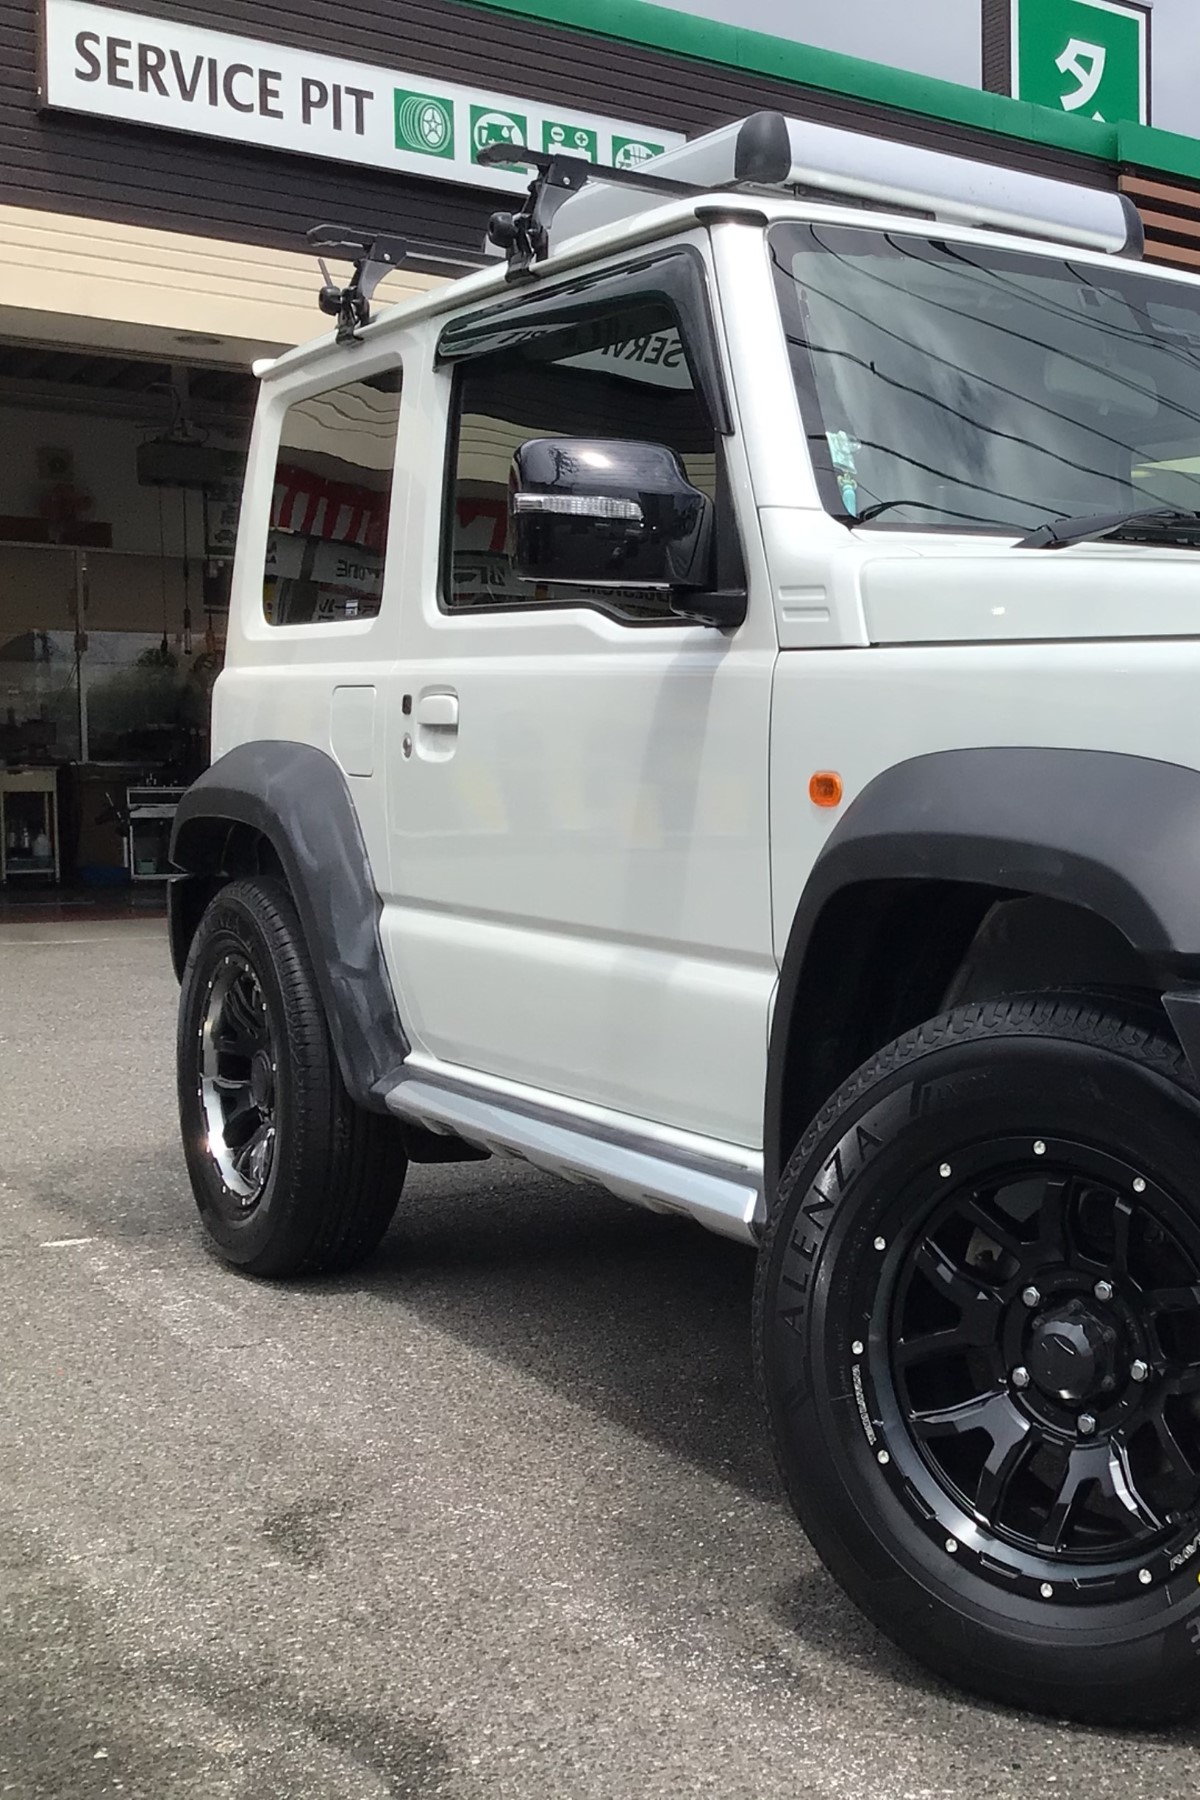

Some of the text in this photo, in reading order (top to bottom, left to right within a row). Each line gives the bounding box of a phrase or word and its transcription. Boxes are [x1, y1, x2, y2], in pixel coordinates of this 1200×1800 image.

[74, 30, 374, 136] SERVICE PIT
[1054, 37, 1106, 123] タ
[778, 1125, 884, 1335] ALENZA
